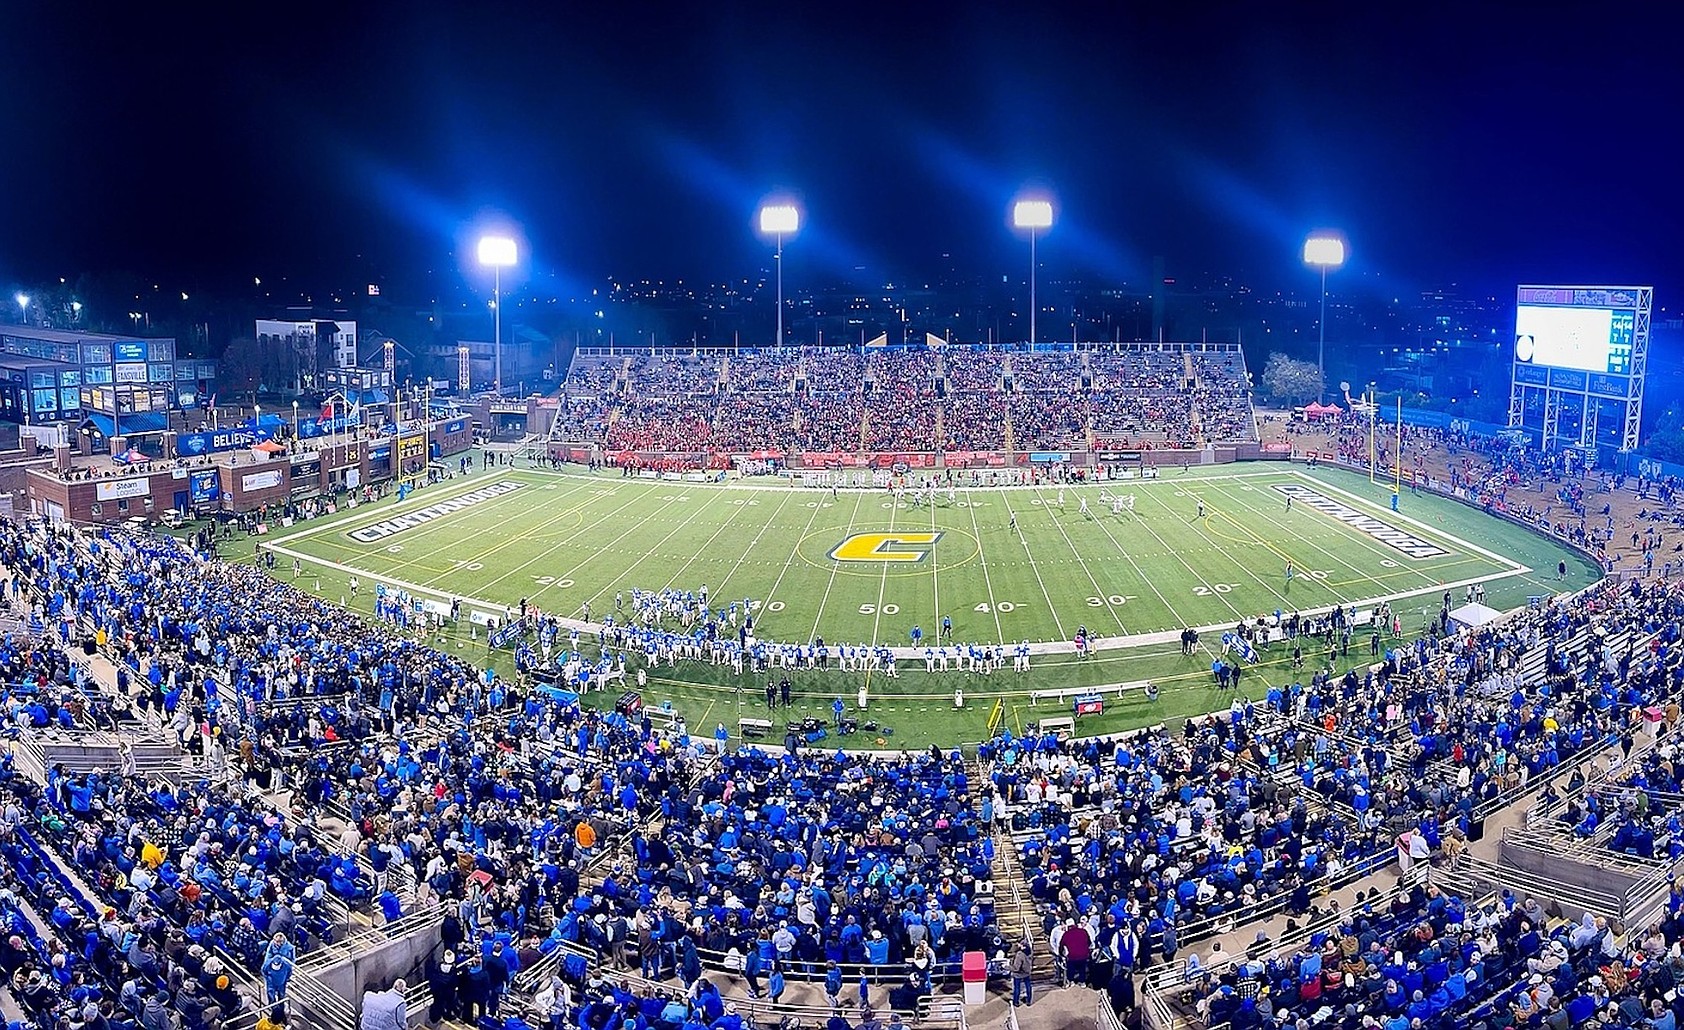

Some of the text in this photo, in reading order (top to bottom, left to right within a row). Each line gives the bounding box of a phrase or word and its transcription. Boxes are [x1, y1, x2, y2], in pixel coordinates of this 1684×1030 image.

[116, 481, 138, 491] Steam
[350, 480, 527, 542] CHATTANOOGA
[536, 575, 576, 589] 20
[1192, 582, 1232, 596] 20
[974, 601, 1015, 614] 40
[1085, 594, 1127, 608] 30
[858, 603, 900, 616] 50
